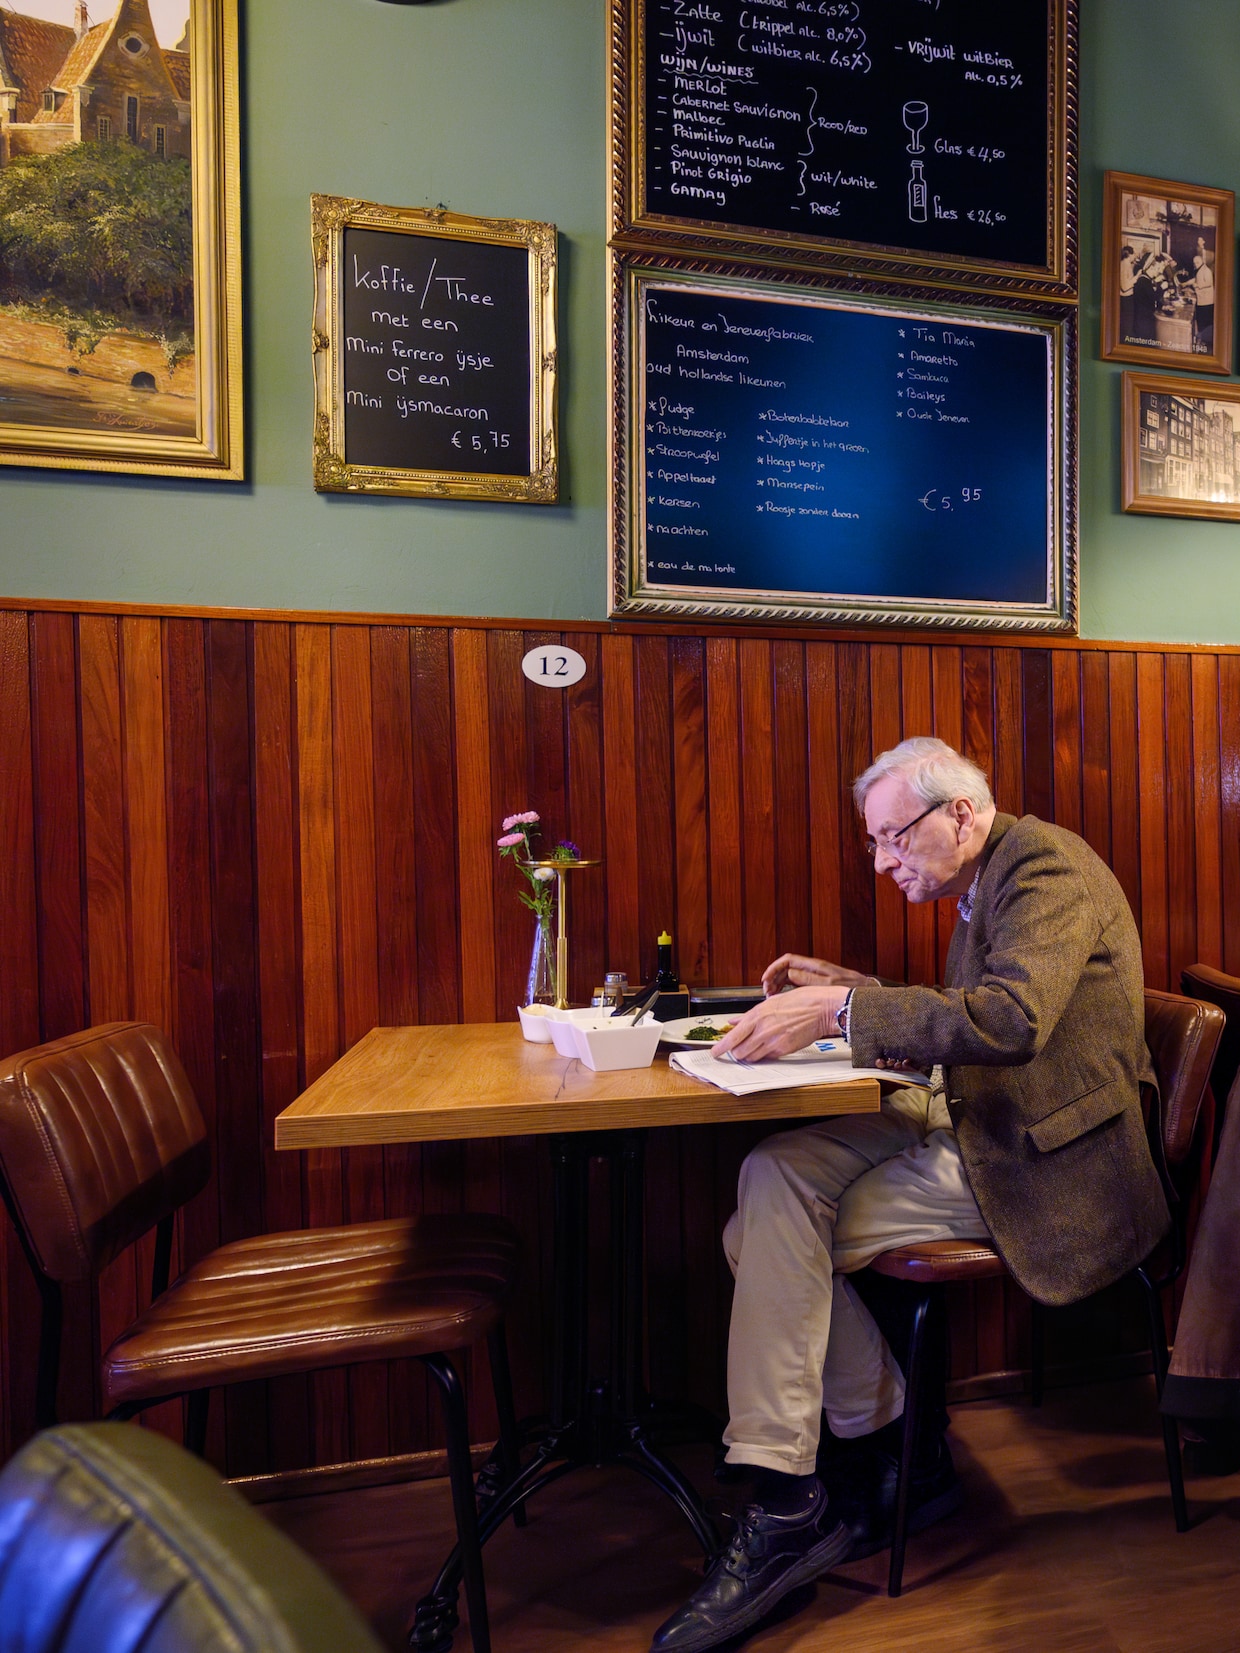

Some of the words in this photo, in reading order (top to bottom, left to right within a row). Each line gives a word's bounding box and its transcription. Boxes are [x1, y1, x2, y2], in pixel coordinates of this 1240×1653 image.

[671, 161, 703, 178] Pinot
[421, 317, 458, 332] een
[913, 327, 936, 342] Tia
[1125, 335, 1161, 347] Amsterdam
[418, 374, 450, 387] een
[540, 656, 569, 676] 12
